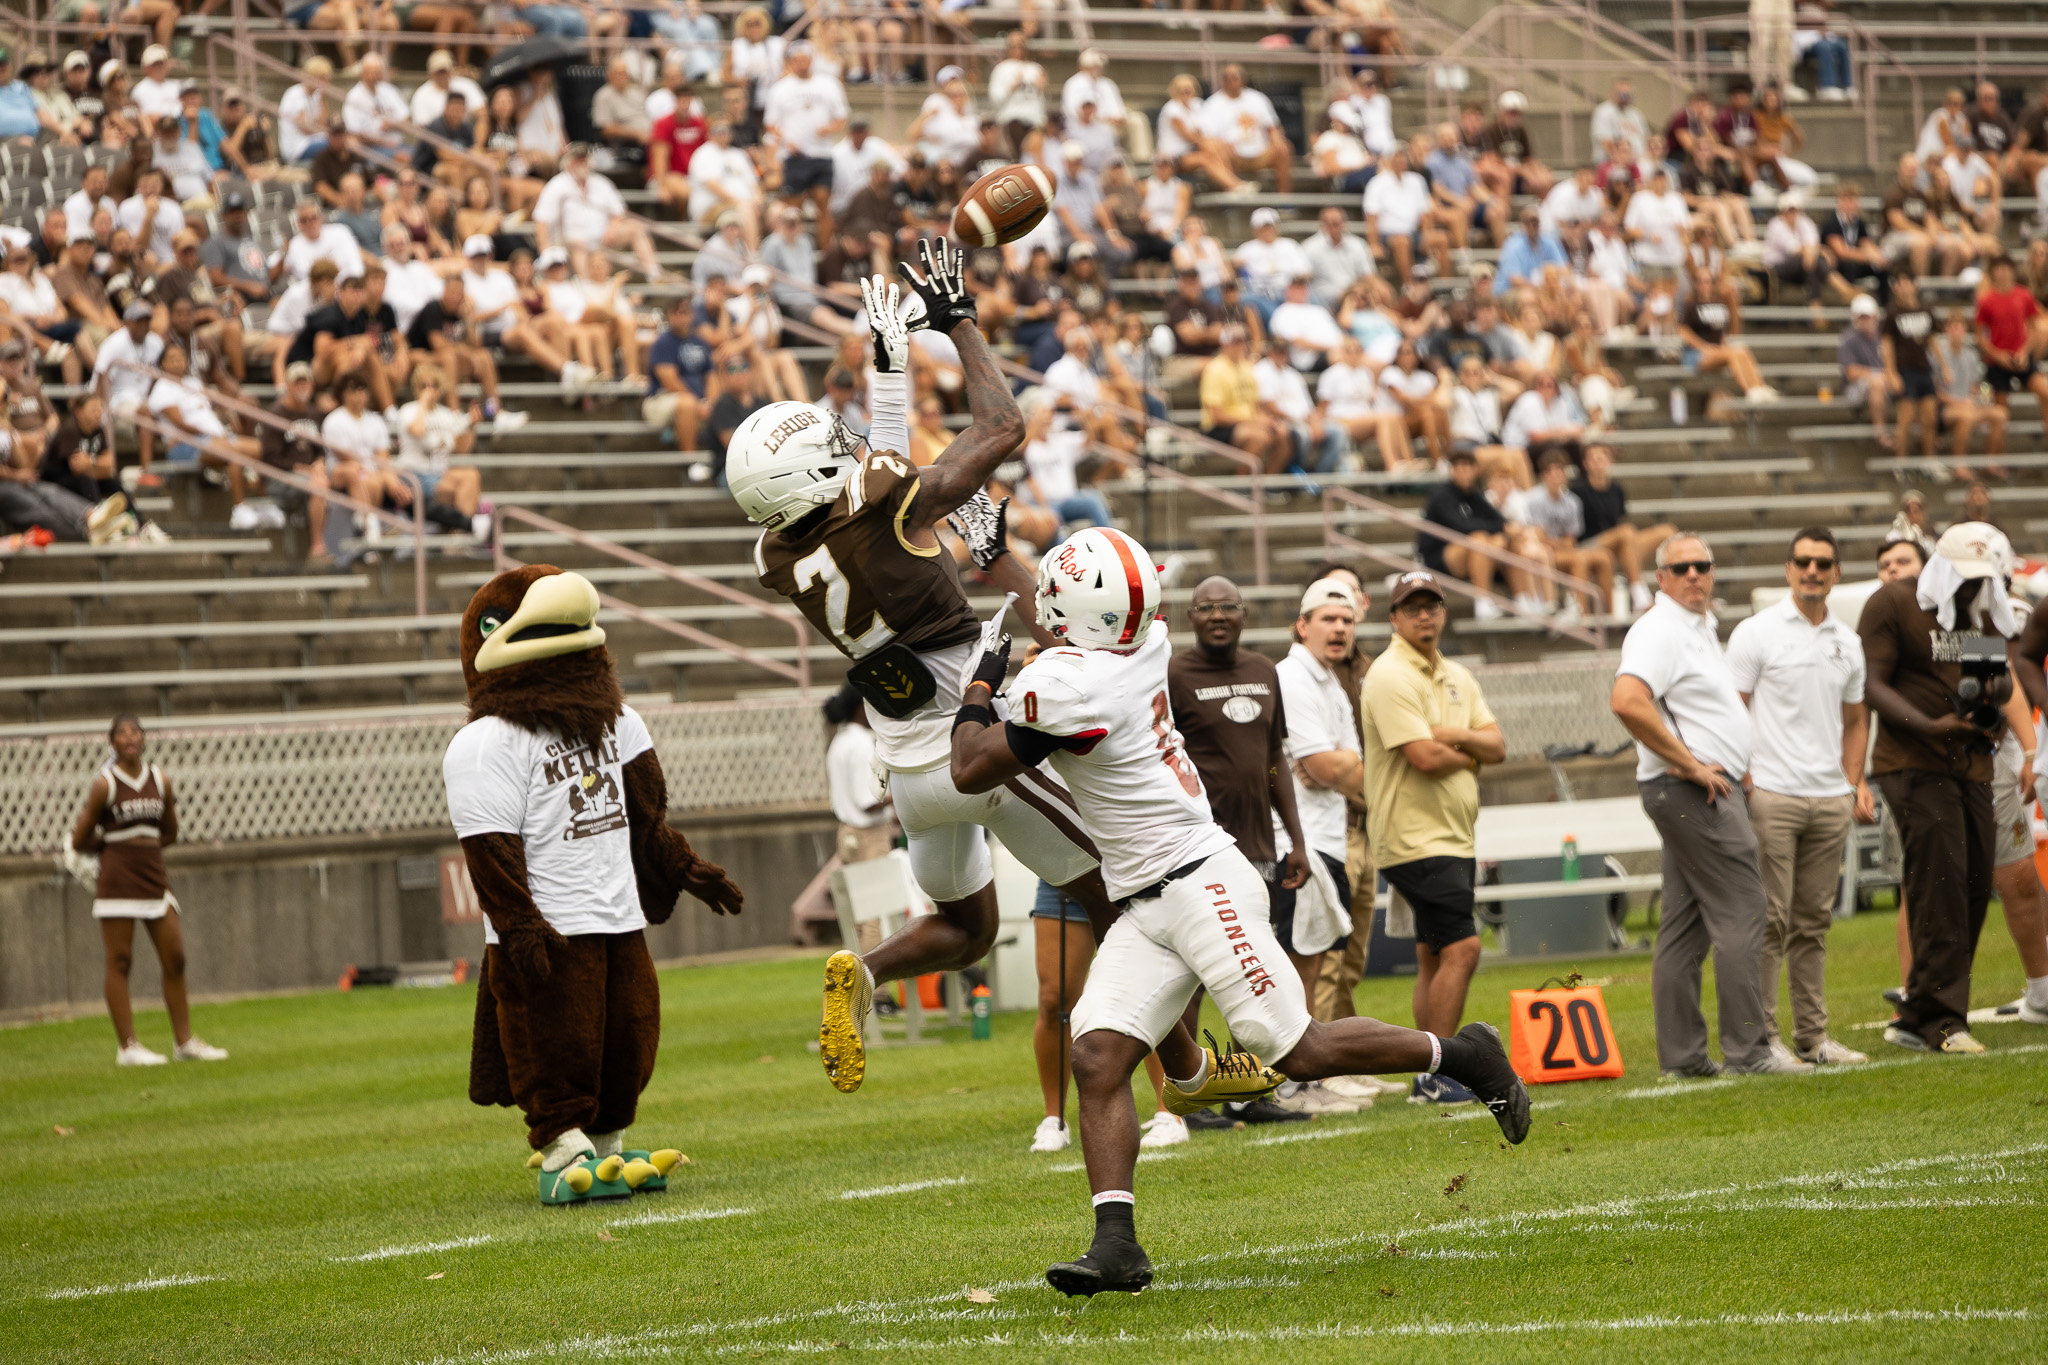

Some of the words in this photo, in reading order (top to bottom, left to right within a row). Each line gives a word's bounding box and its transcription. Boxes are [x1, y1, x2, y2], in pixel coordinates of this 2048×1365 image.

[763, 411, 821, 455] LEHIGH
[871, 455, 908, 478] 2
[1054, 544, 1086, 582] Pios
[793, 543, 899, 660] 2
[1024, 691, 1038, 723] 0
[1195, 685, 1232, 701] LEHIGH
[1231, 683, 1271, 696] FOOTBALL
[1204, 883, 1276, 996] PIONEERS
[1529, 999, 1609, 1070] 20
